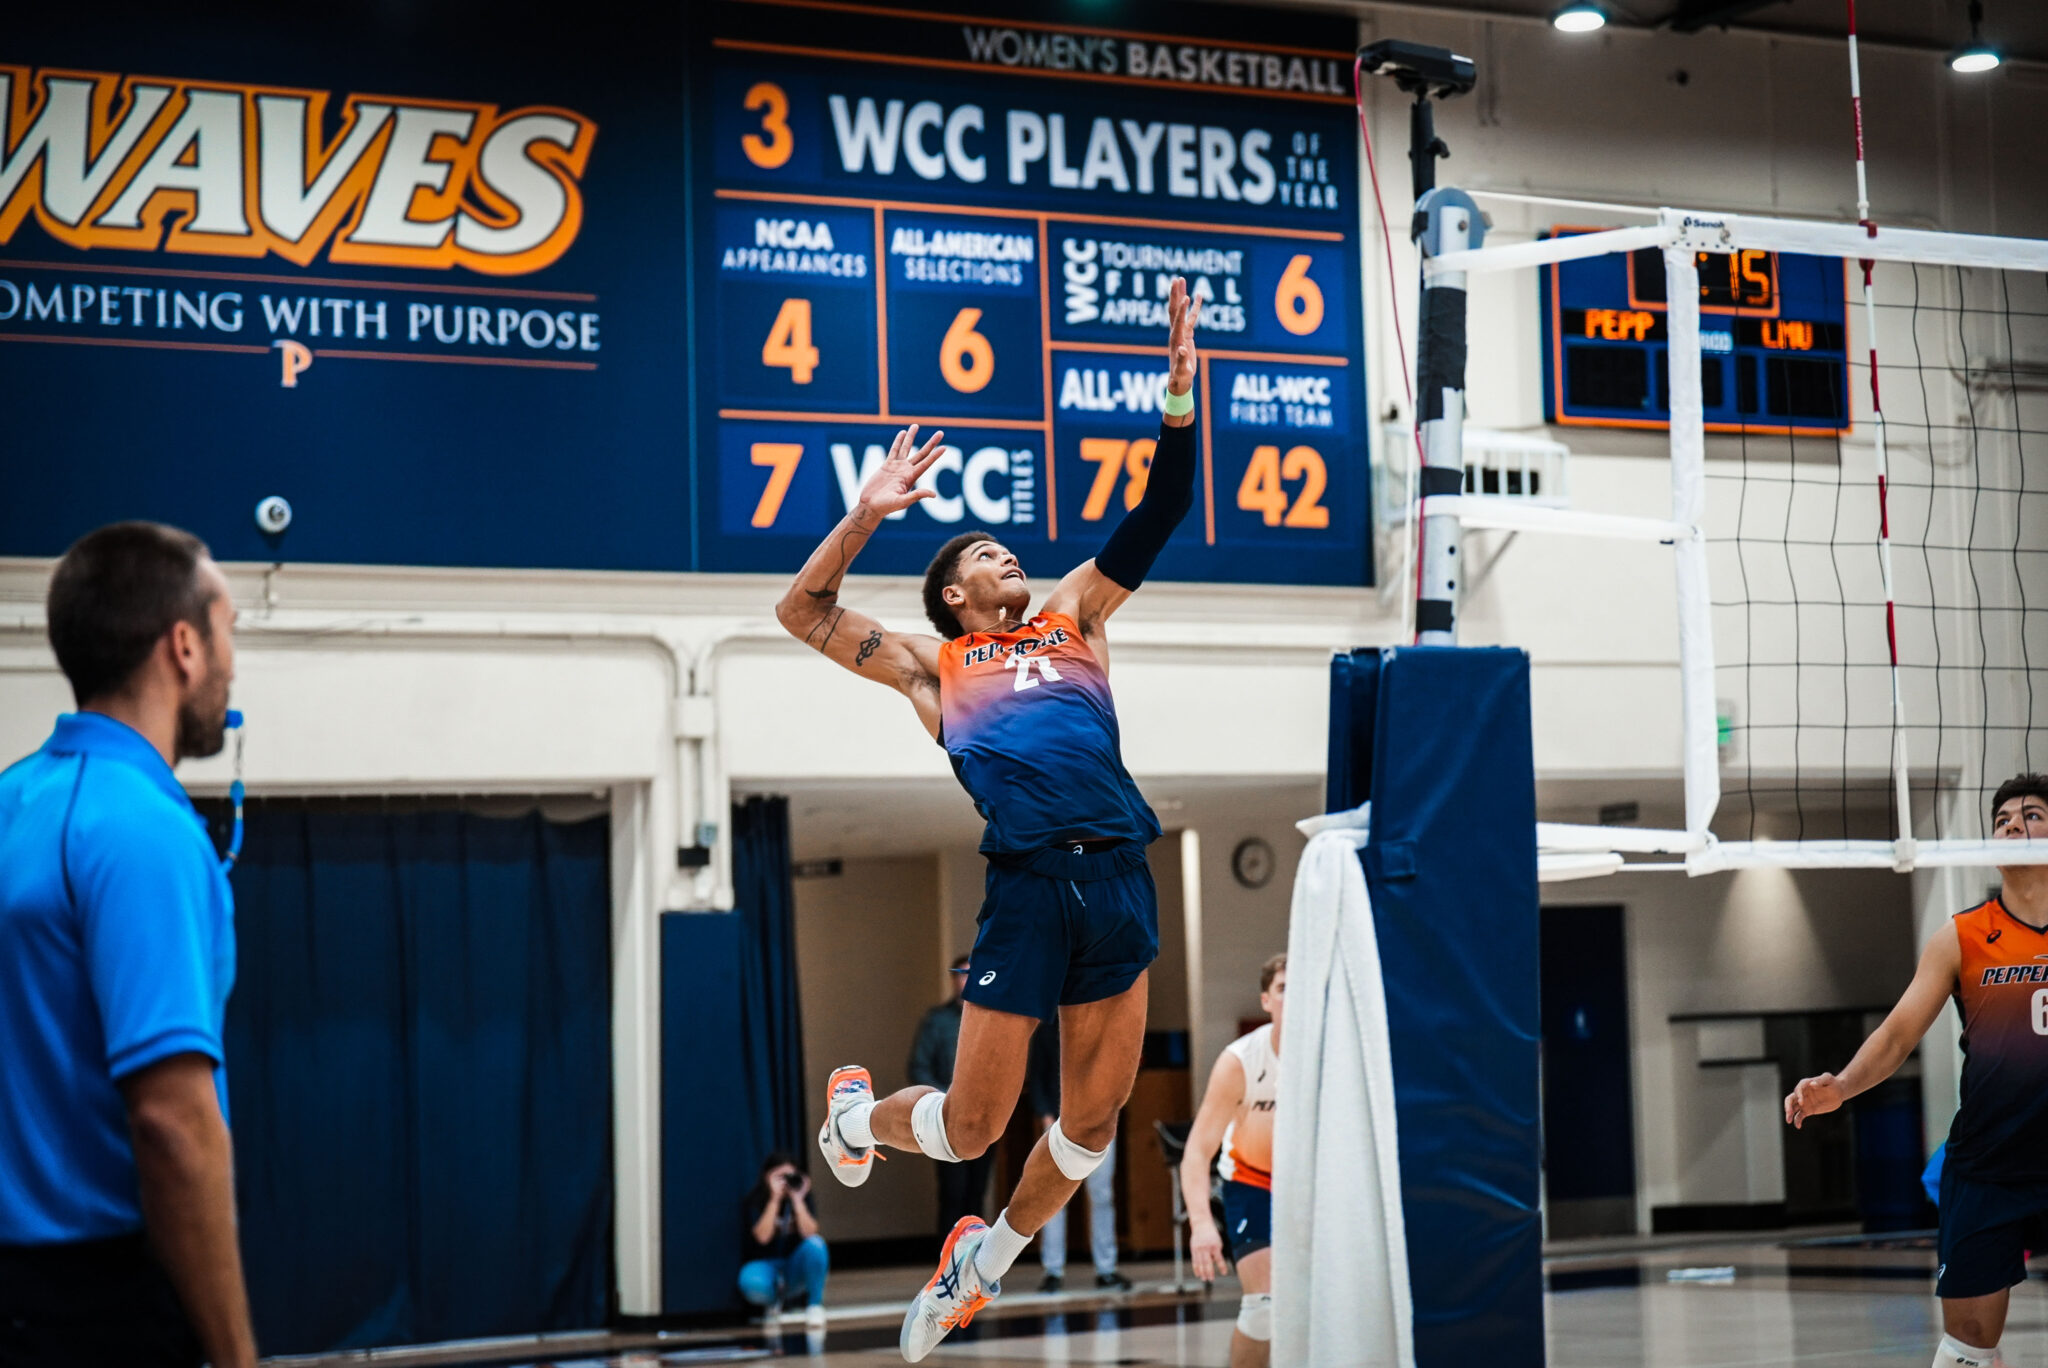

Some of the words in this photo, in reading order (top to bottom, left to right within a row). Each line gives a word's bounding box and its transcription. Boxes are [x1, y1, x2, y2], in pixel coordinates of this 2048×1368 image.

[963, 26, 1119, 73] WOMEN'S
[1127, 42, 1345, 95] BASKETBALL
[741, 81, 794, 169] 3
[828, 94, 987, 181] WCC
[1007, 110, 1276, 205] PLAYERS
[1291, 131, 1321, 155] OF
[0, 65, 597, 275] WAVES
[1285, 156, 1330, 182] THE
[1279, 182, 1339, 209] YEAR
[755, 218, 834, 251] NCAA
[891, 227, 1034, 263] ALL-AMERICAN
[722, 248, 867, 278] APPEARANCES
[904, 257, 1023, 286] SELECTIONS
[1101, 241, 1244, 275] TOURNAMENT
[1062, 238, 1099, 324] WCC
[1274, 254, 1324, 336] 6
[261, 294, 388, 339] WITH
[409, 303, 600, 351] PURPOSE
[1101, 299, 1247, 332] APPEANCES
[1585, 309, 1655, 341] PEPP
[1761, 319, 1813, 350] LMU
[762, 298, 819, 385] 4
[939, 308, 994, 393] 6
[271, 339, 313, 388] P
[1231, 373, 1332, 406] ALL-WCC
[1230, 402, 1278, 425] FIRST
[1285, 404, 1334, 427] TEAM
[750, 443, 803, 529] 7
[1010, 449, 1035, 524] TITLES
[1080, 437, 1158, 521] 78
[1237, 445, 1329, 529] 42
